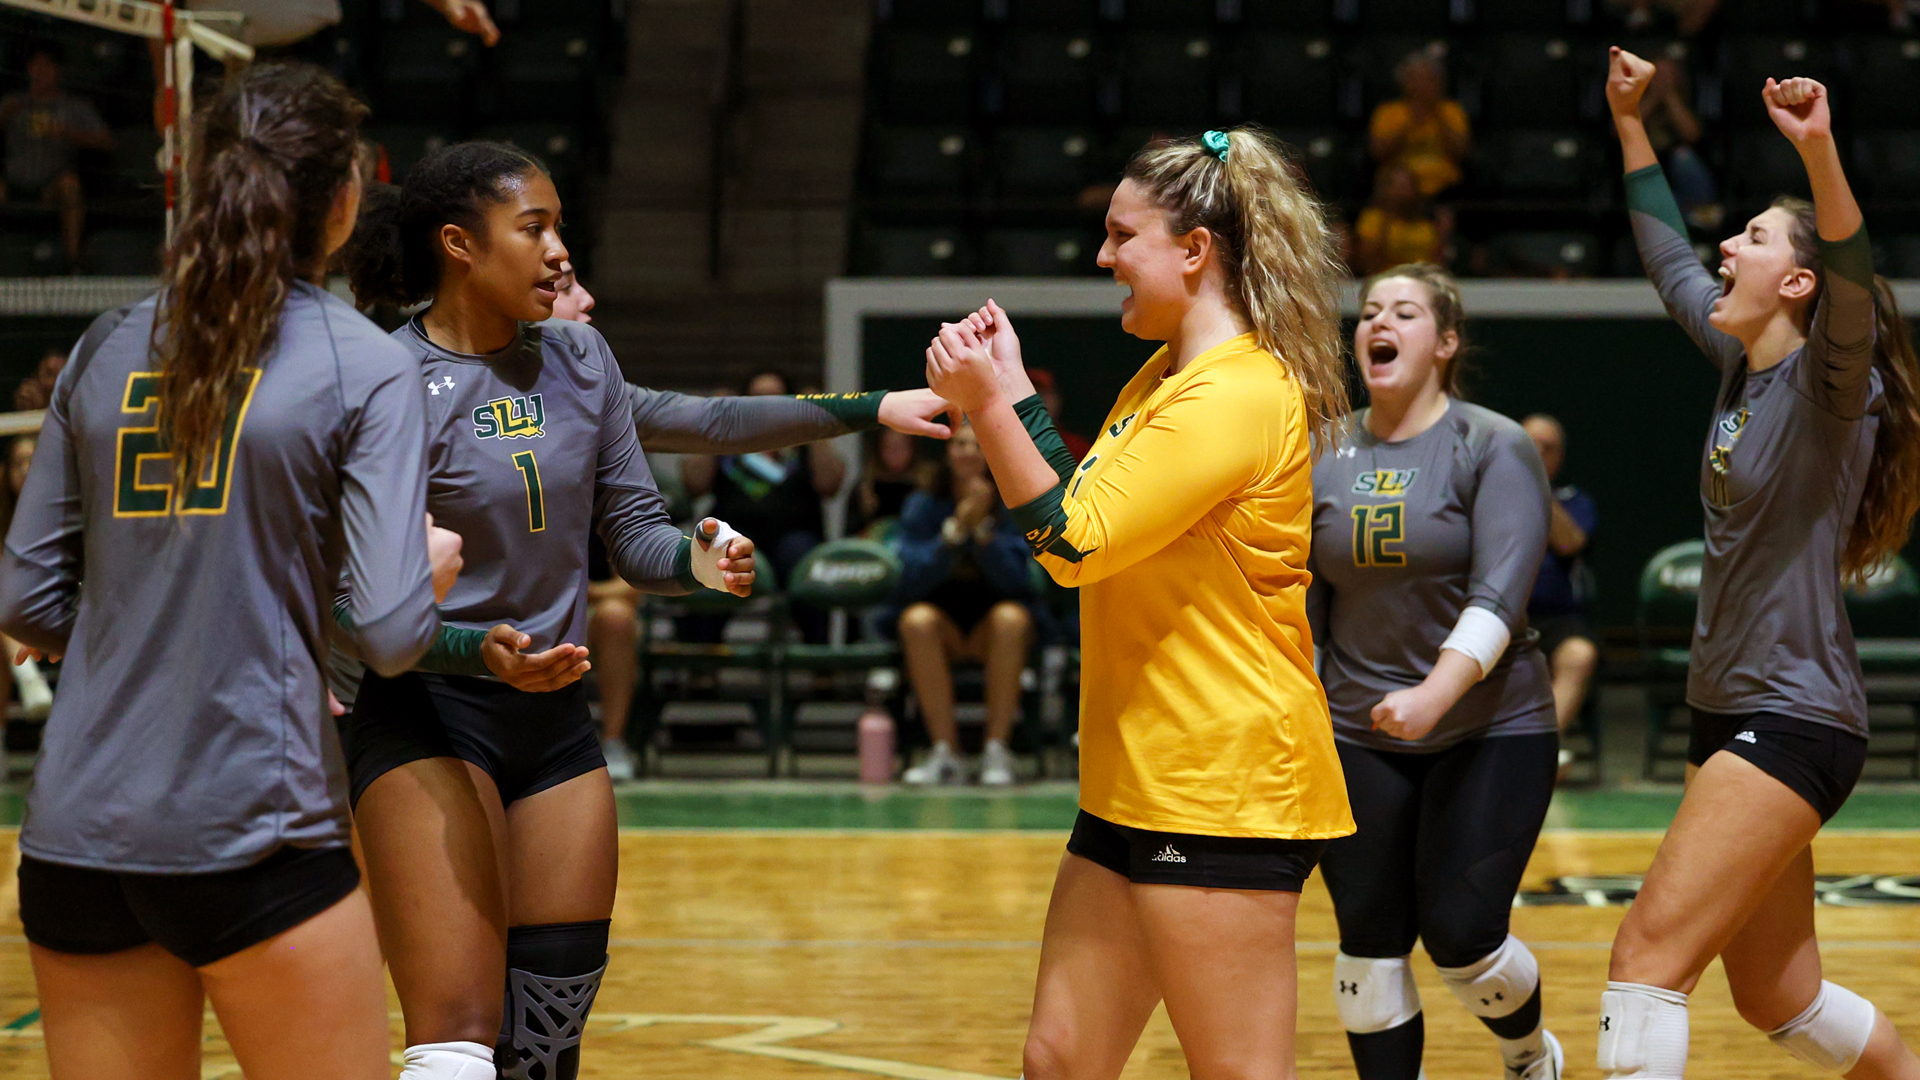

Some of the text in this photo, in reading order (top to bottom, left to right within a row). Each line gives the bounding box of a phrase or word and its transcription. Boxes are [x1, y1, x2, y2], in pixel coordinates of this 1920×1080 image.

[472, 394, 546, 440] SLU
[511, 450, 546, 532] 1
[1351, 468, 1420, 498] SLU
[1351, 501, 1406, 567] 12
[1151, 852, 1187, 863] didas
